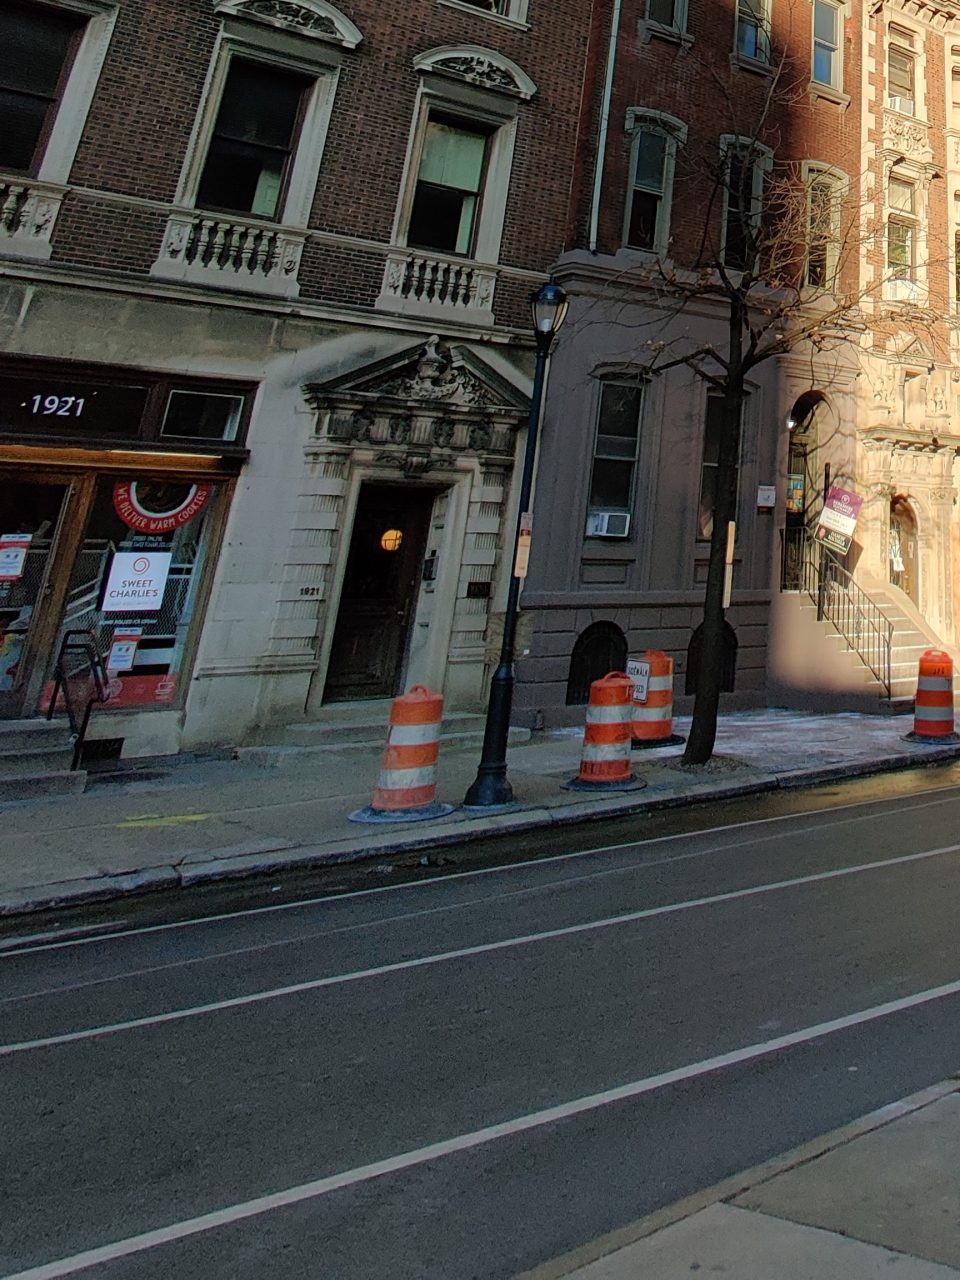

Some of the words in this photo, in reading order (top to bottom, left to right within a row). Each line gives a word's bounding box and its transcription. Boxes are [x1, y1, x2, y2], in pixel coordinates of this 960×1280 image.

[32, 394, 85, 417] 1921
[117, 486, 129, 500] WE
[178, 490, 208, 522] COOKIES
[119, 501, 148, 528] DELIVER
[149, 518, 176, 530] WARM
[121, 579, 153, 589] SWEET
[109, 589, 159, 599] CHARLIE'S
[300, 587, 320, 596] 1921
